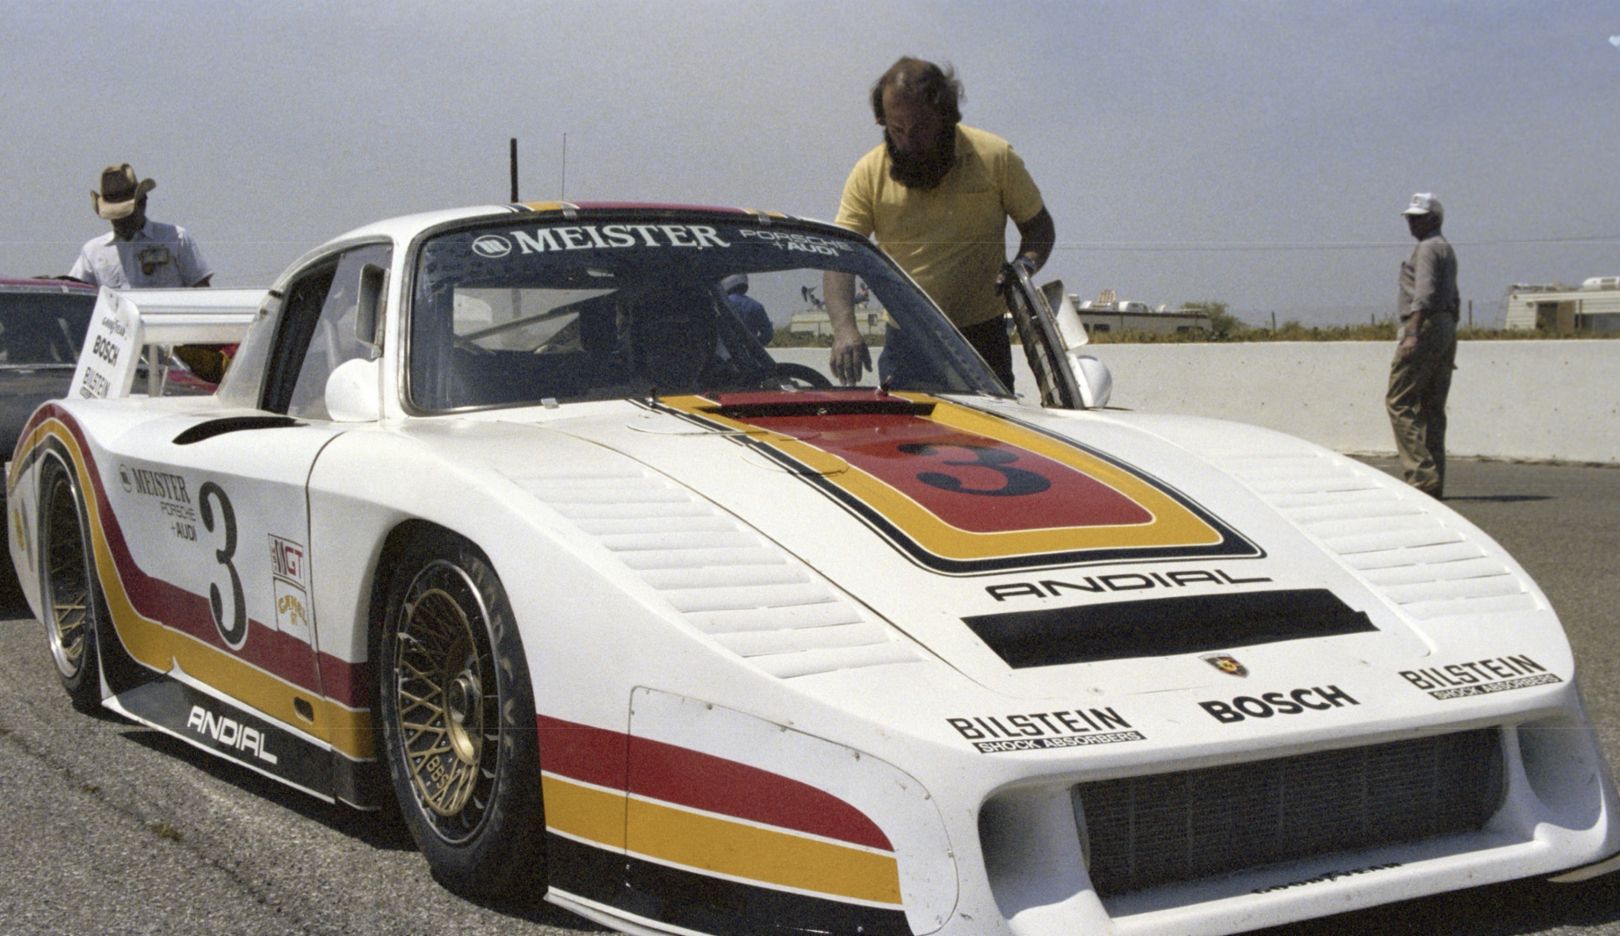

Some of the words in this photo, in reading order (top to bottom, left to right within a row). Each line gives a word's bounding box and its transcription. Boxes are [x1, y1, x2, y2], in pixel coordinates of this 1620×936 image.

[510, 225, 731, 254] MEISTER
[740, 229, 854, 251] PORSCHE
[93, 335, 121, 366] BOSCH
[132, 467, 191, 504] MEISTER
[896, 443, 1052, 497] 3
[160, 501, 196, 522] PORSCHE
[199, 481, 247, 645] 3
[985, 569, 1274, 602] ANDIAL
[1398, 653, 1547, 690] BILSTEIN
[1198, 685, 1361, 724] BOSCH
[186, 704, 278, 765] ANDIAL
[946, 706, 1132, 740] BILSTEIN
[978, 739, 1040, 754] SHOCK
[1043, 731, 1142, 749] ABSORBERS
